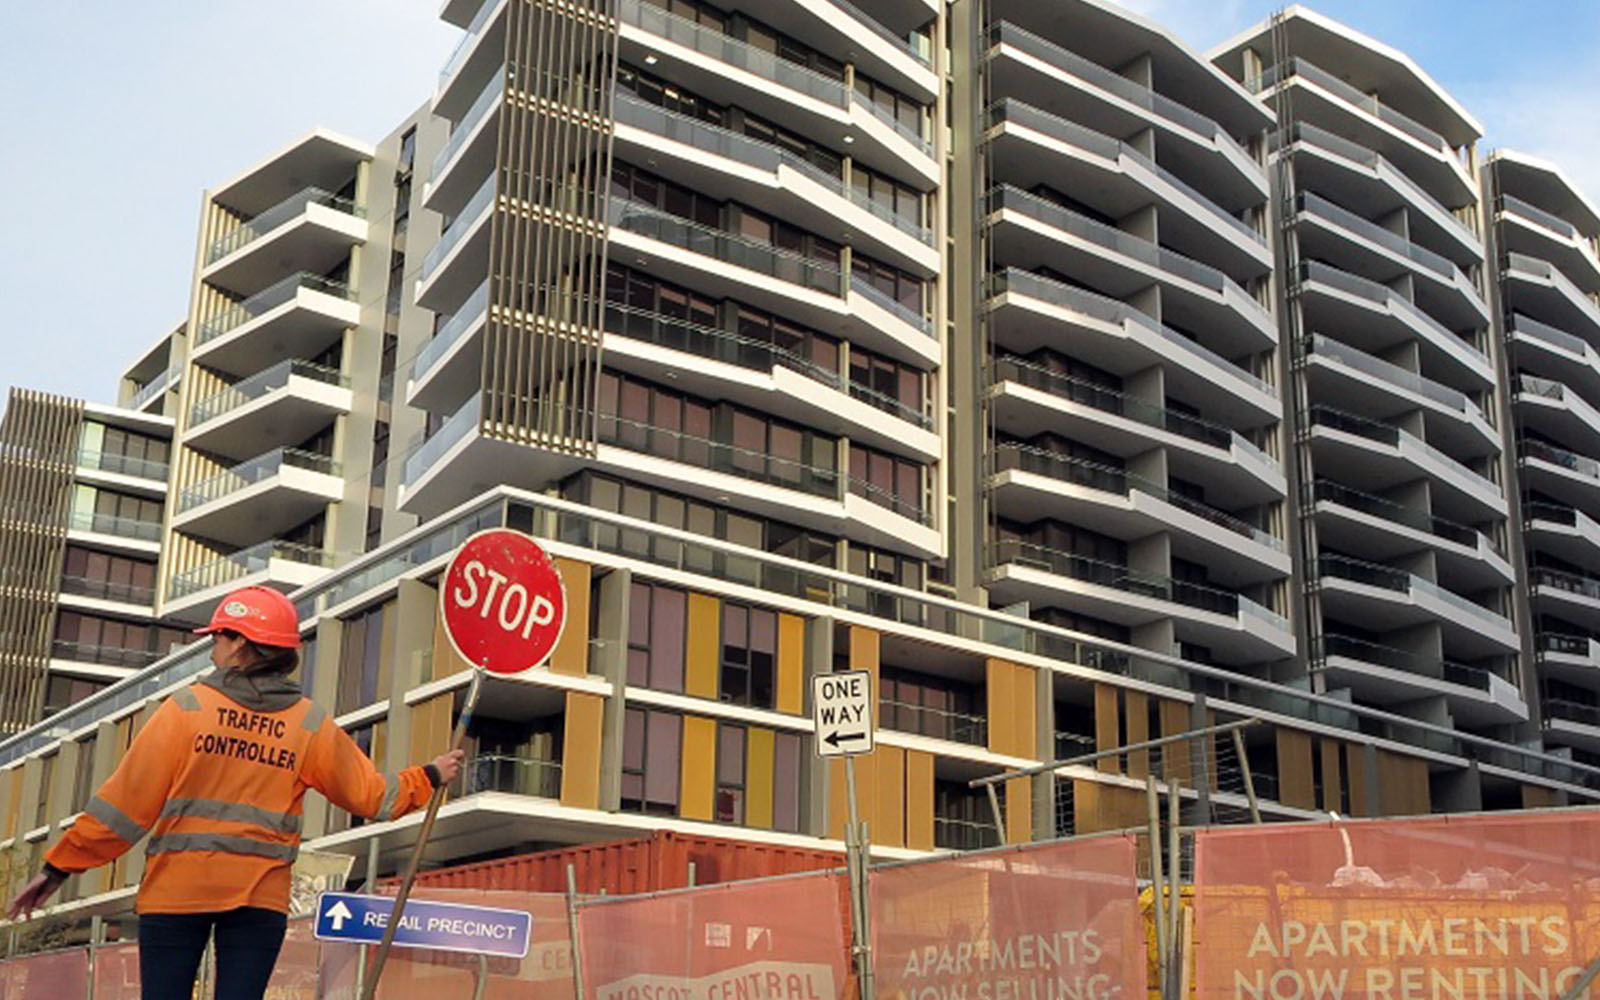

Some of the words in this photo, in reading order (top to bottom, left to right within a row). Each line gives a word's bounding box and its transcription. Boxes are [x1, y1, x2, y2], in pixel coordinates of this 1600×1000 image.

[454, 560, 555, 640] STOP
[822, 678, 862, 700] ONE
[217, 707, 286, 738] TRAFFIC
[820, 704, 865, 725] WAY
[195, 734, 296, 771] CONTROLLER
[363, 911, 422, 932] REAIL
[427, 917, 516, 940] PRECINCT
[1247, 915, 1568, 958] APARTMENTS
[902, 929, 1102, 978] APARTMENTS
[608, 984, 691, 1000] ASCO
[708, 971, 820, 1000] CENTRAL
[1233, 968, 1349, 1000] NOW
[1366, 965, 1590, 1000] RENTING
